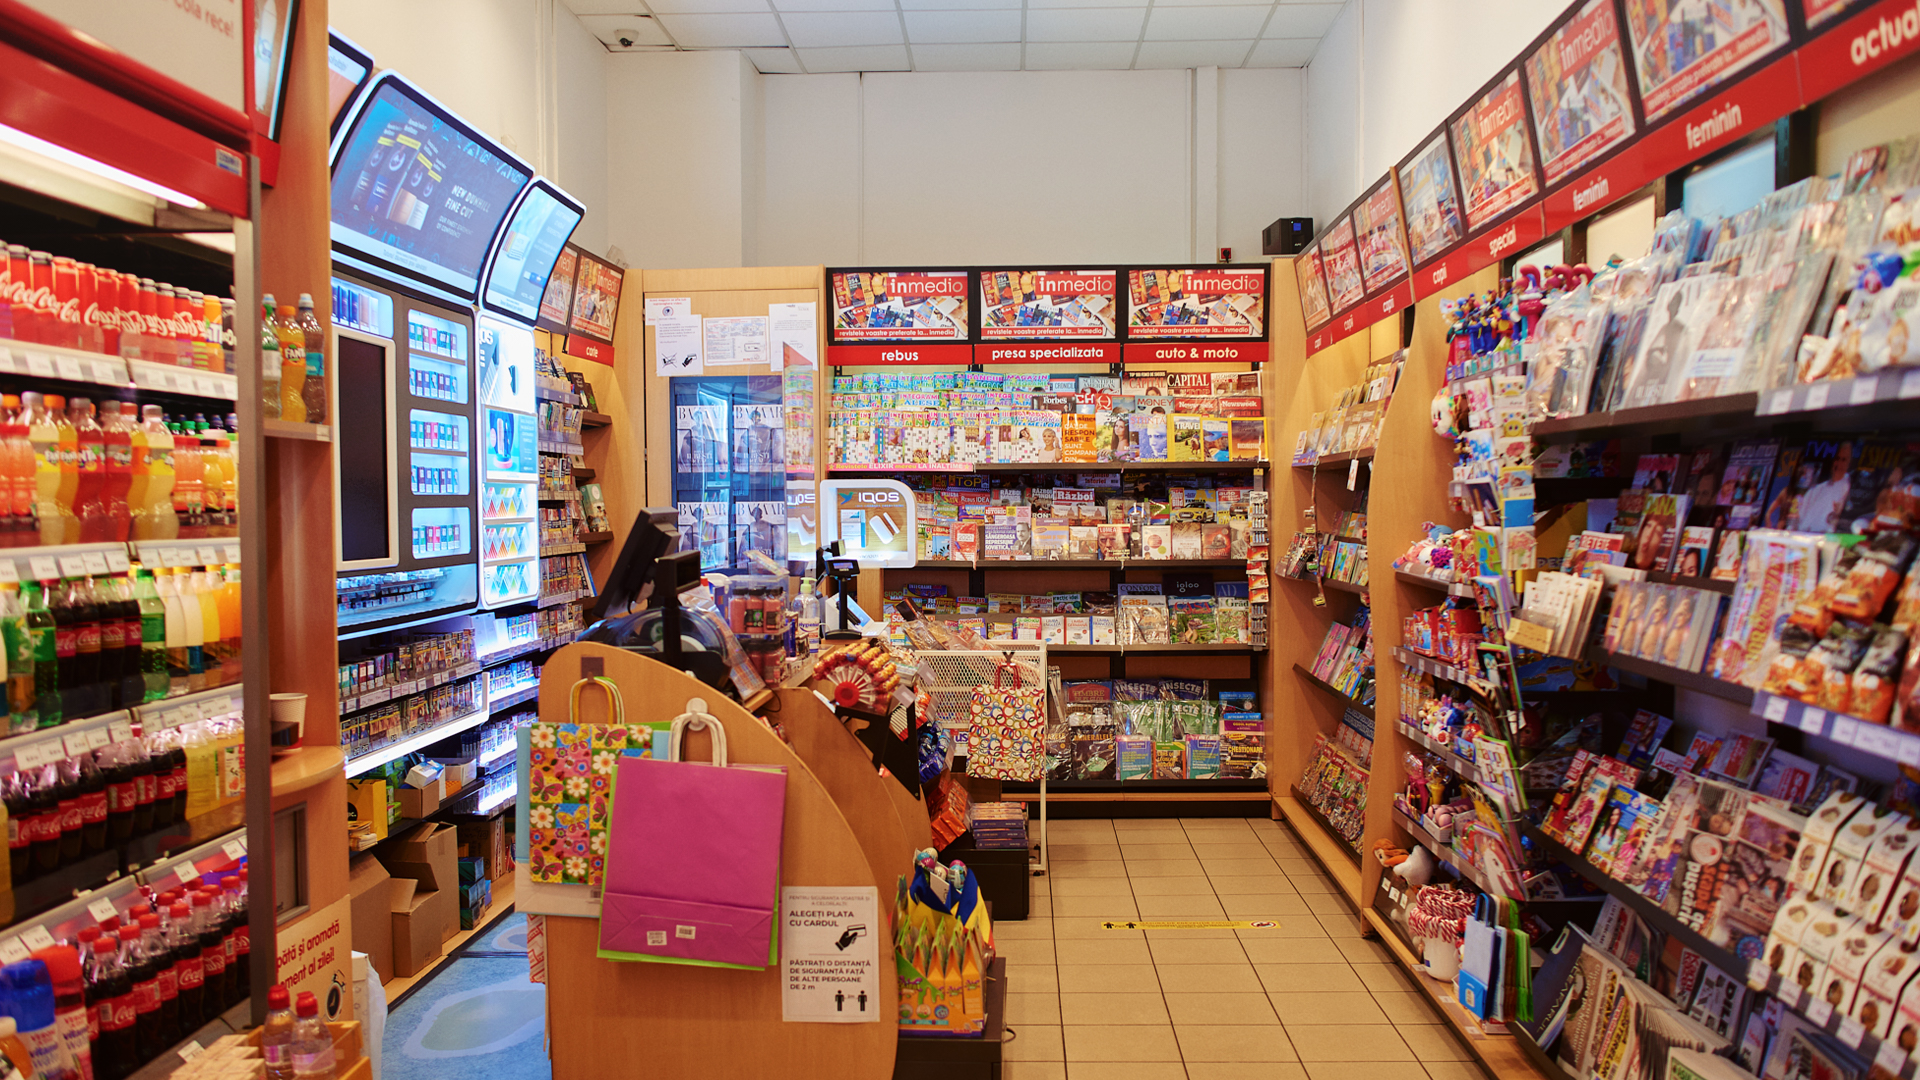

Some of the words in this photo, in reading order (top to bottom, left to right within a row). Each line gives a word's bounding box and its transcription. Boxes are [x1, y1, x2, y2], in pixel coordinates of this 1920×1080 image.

[205, 9, 234, 39] rece!
[1560, 7, 1614, 72] inmedio
[1479, 90, 1520, 140] inmedio
[1686, 102, 1742, 151] feminin
[452, 184, 467, 198] NEW
[1573, 176, 1609, 212] feminin
[445, 197, 461, 213] FINE
[460, 206, 474, 219] CUT
[1489, 224, 1517, 256] special
[890, 278, 963, 294] inmedio
[1039, 277, 1112, 293] inmedio
[1187, 276, 1259, 291] inmedio
[839, 329, 864, 337] revistele
[889, 329, 917, 338] preferate
[1038, 328, 1066, 336] preferate
[1183, 327, 1211, 335] preferate
[285, 348, 305, 360] FANT
[882, 350, 919, 361] rebus
[992, 349, 1027, 361] presa
[1029, 348, 1104, 360] specializata
[1156, 348, 1186, 359] auto
[1190, 348, 1199, 359] &
[1204, 347, 1238, 359] moto
[1130, 379, 1166, 388] CAPITAL
[1167, 374, 1209, 387] CAPITAL
[1137, 399, 1174, 407] MONEY
[1175, 422, 1200, 430] TRAVE
[858, 492, 900, 504] IQOS
[1058, 491, 1093, 501] Război
[1176, 581, 1199, 593] igloo
[1225, 597, 1249, 608] Grăd
[1116, 682, 1157, 694] INSECTE
[1164, 681, 1202, 694] INSECTE
[789, 911, 825, 919] ALEGEȚI
[298, 938, 305, 961] și
[307, 919, 340, 952] aromată
[308, 957, 316, 976] al
[317, 947, 335, 971] zilei!
